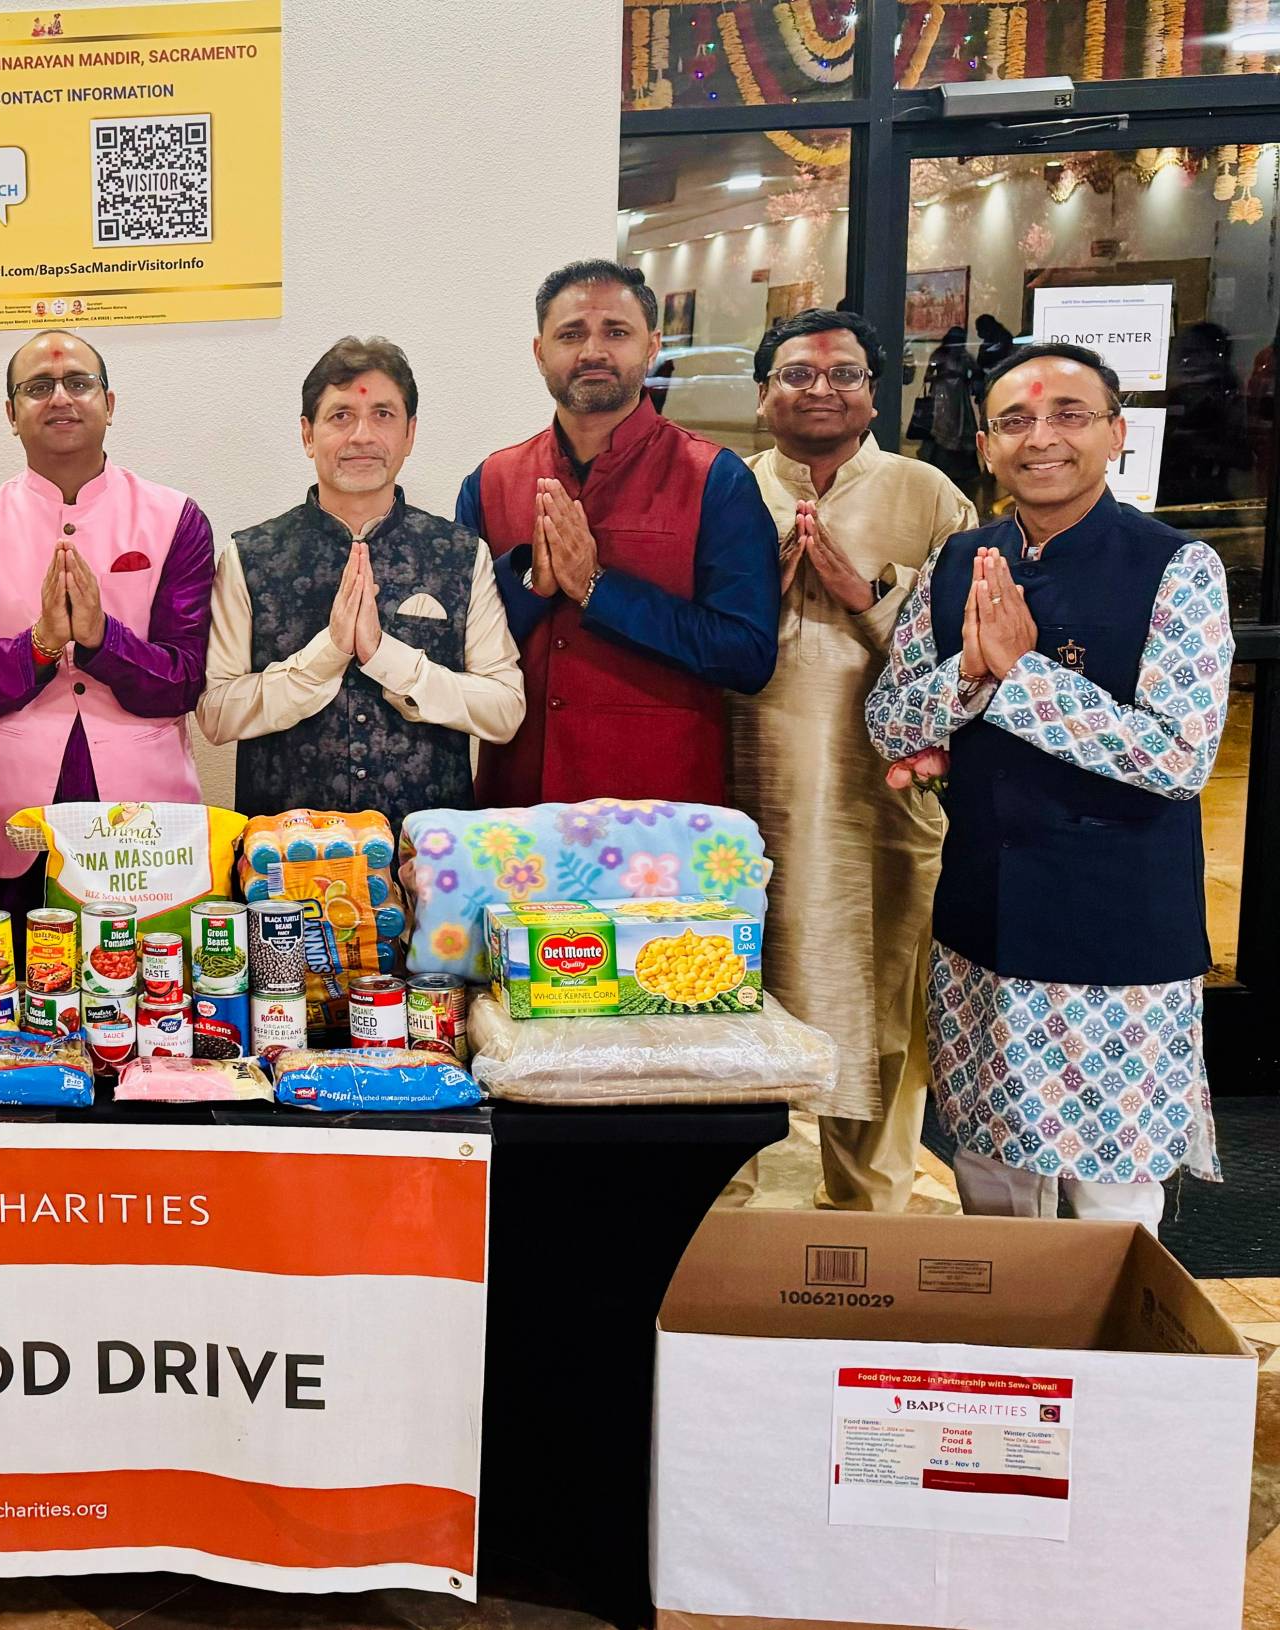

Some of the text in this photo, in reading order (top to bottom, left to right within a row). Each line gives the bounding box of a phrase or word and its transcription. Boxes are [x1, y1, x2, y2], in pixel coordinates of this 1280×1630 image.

[79, 51, 145, 67] MANDIR,
[148, 44, 258, 64] SACRAMENTO
[67, 83, 175, 102] INFORMATION
[126, 172, 179, 193] VISITOR
[1050, 332, 1152, 344] DO NOT ENTER
[115, 846, 194, 869] MASOORI
[109, 870, 148, 892] RICE
[84, 888, 100, 900] RIZ
[129, 891, 174, 902] MASOORI
[110, 930, 130, 940] Diced
[207, 928, 228, 937] Green
[739, 925, 753, 942] 8
[207, 937, 230, 946] Beans
[737, 942, 756, 951] CANS
[543, 946, 602, 959] Del Monte
[560, 960, 586, 969] Quality
[144, 968, 170, 978] PASTE
[533, 990, 616, 1000] WHOLE KERNEL CORN
[260, 1014, 294, 1023] Rosarita
[351, 1013, 378, 1028] DICED
[408, 1015, 434, 1030] CHILI
[205, 1023, 232, 1035] Beans
[319, 1089, 351, 1102] Rotini
[779, 1290, 895, 1308] 1006210029
[98, 1338, 326, 1411] DRIVE
[857, 1373, 878, 1382] Food
[879, 1373, 901, 1383] Drive
[902, 1374, 921, 1383] 2024
[937, 1377, 987, 1389] Partnership
[987, 1379, 1007, 1389] with
[1007, 1381, 1030, 1390] Sewa
[1032, 1382, 1058, 1392] Diwali
[906, 1399, 1028, 1417] BAPS CHARITIES
[942, 1427, 973, 1436] Donate
[941, 1436, 964, 1445] Food
[940, 1445, 973, 1455] Clothes
[929, 1458, 943, 1466] Oct
[955, 1460, 970, 1468] Nov
